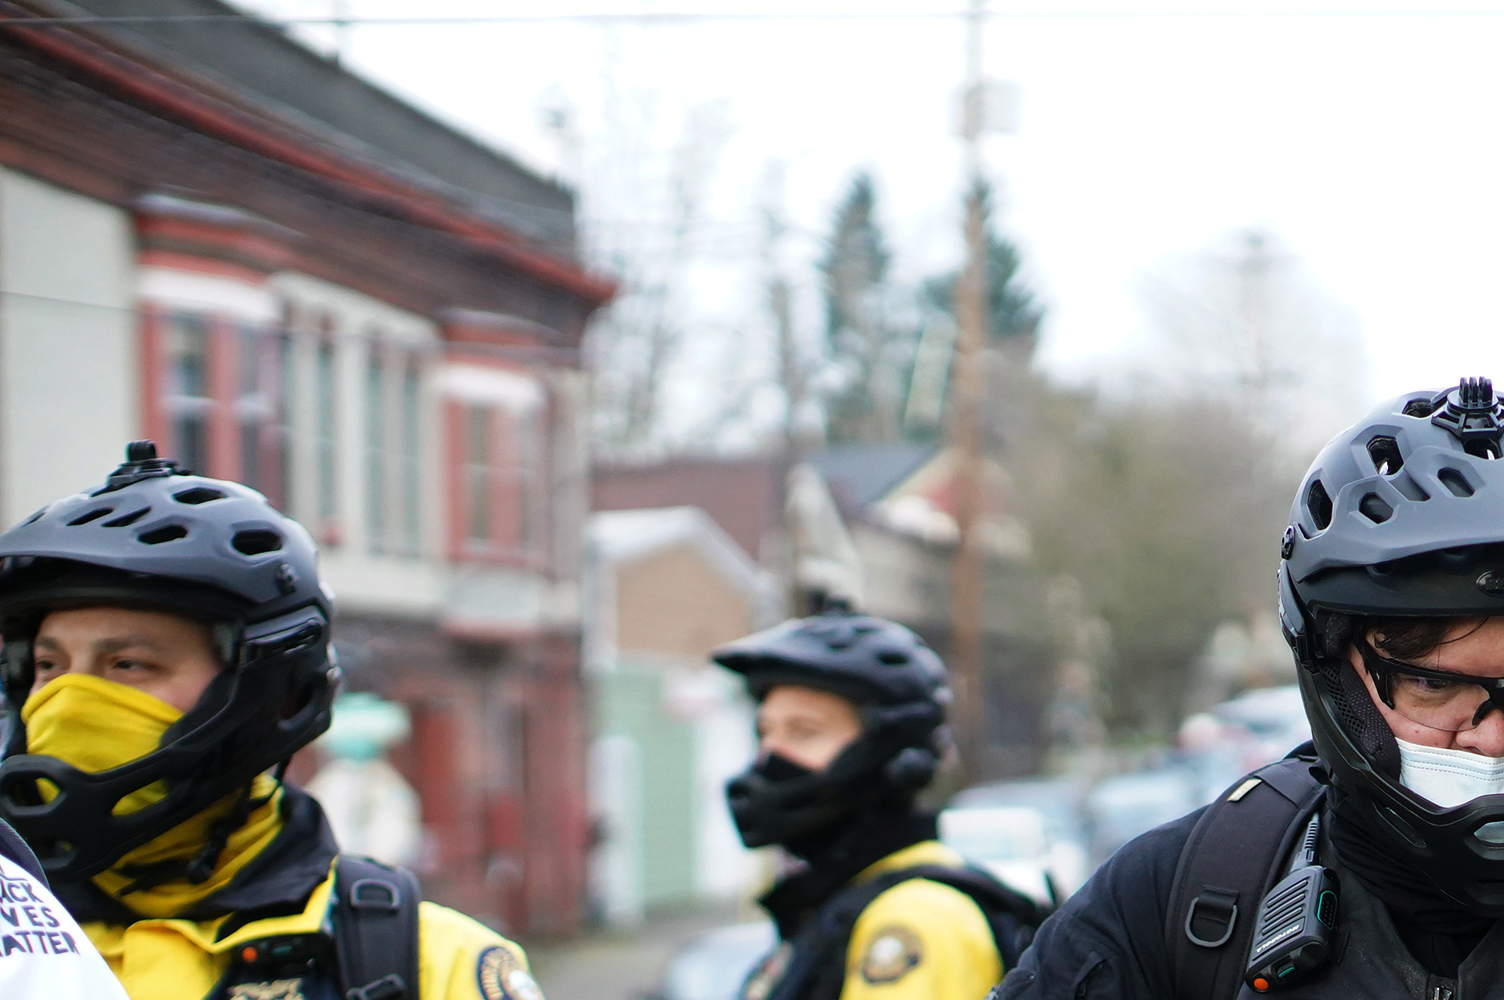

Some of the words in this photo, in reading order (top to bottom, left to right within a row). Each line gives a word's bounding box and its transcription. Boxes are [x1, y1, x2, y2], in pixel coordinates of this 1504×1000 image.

[0, 879, 45, 904] ACK
[0, 905, 60, 928] VES
[0, 931, 81, 957] ATTER
